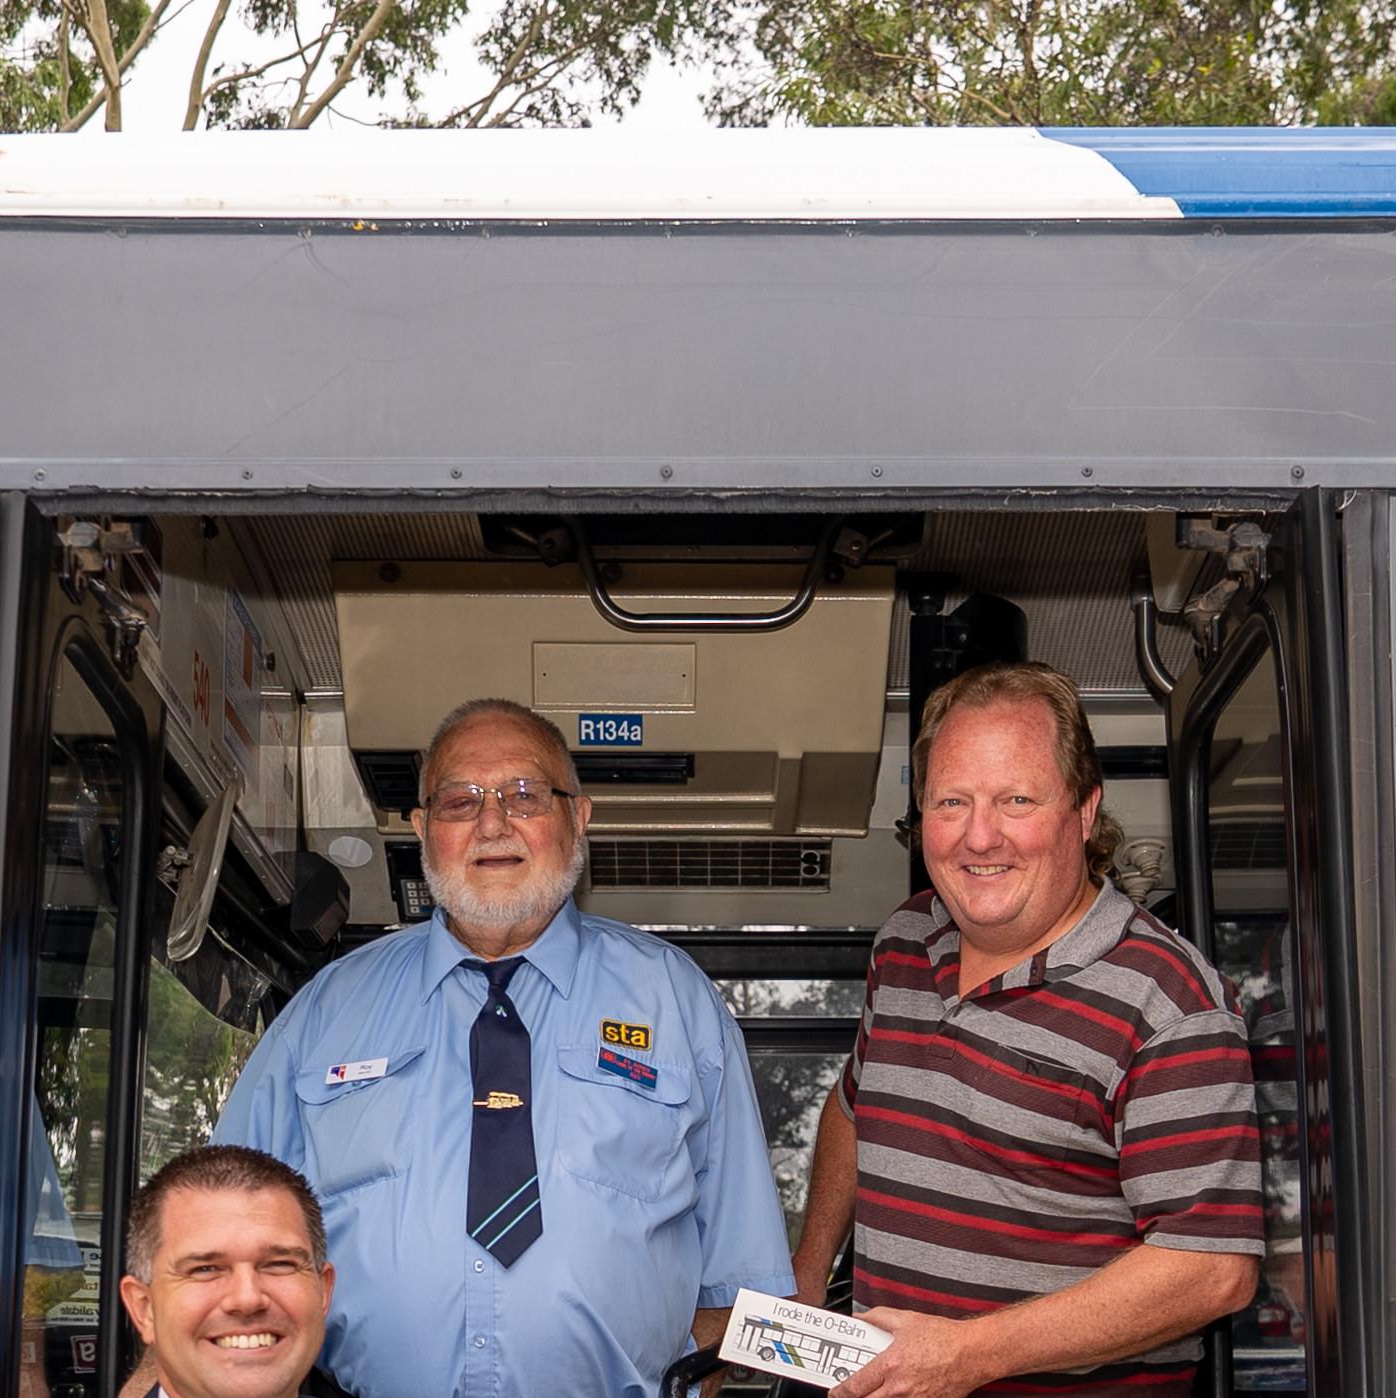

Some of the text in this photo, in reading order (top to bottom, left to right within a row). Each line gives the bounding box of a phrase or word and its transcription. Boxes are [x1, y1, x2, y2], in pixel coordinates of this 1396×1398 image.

[193, 649, 210, 728] 540
[581, 720, 642, 741] R134a
[606, 1025, 646, 1046] sta
[779, 1306, 803, 1321] rode
[804, 1311, 822, 1327] the
[824, 1317, 867, 1340] O-Bahn
